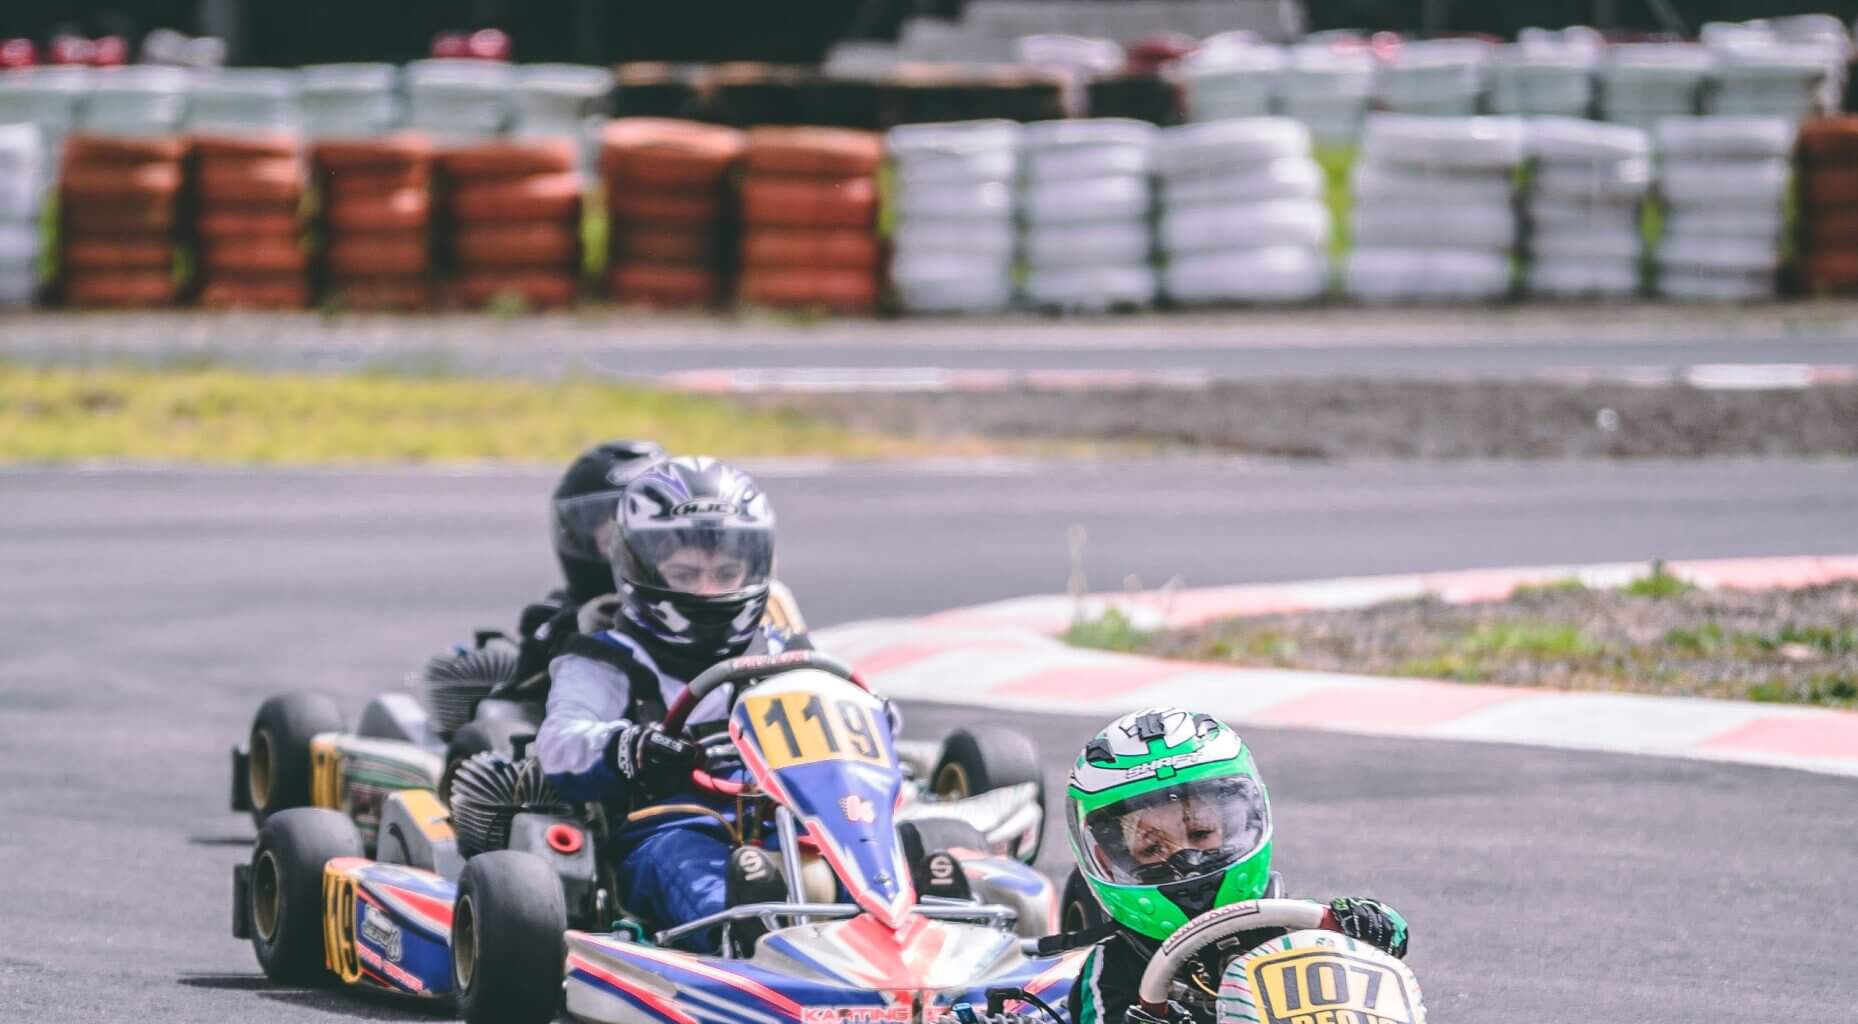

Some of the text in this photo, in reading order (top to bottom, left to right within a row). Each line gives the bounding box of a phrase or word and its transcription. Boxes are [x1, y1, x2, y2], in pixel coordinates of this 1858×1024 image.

[682, 502, 730, 515] HJC
[763, 695, 881, 759] 119
[1282, 962, 1383, 1011] 107
[802, 1006, 911, 1024] KARTING
